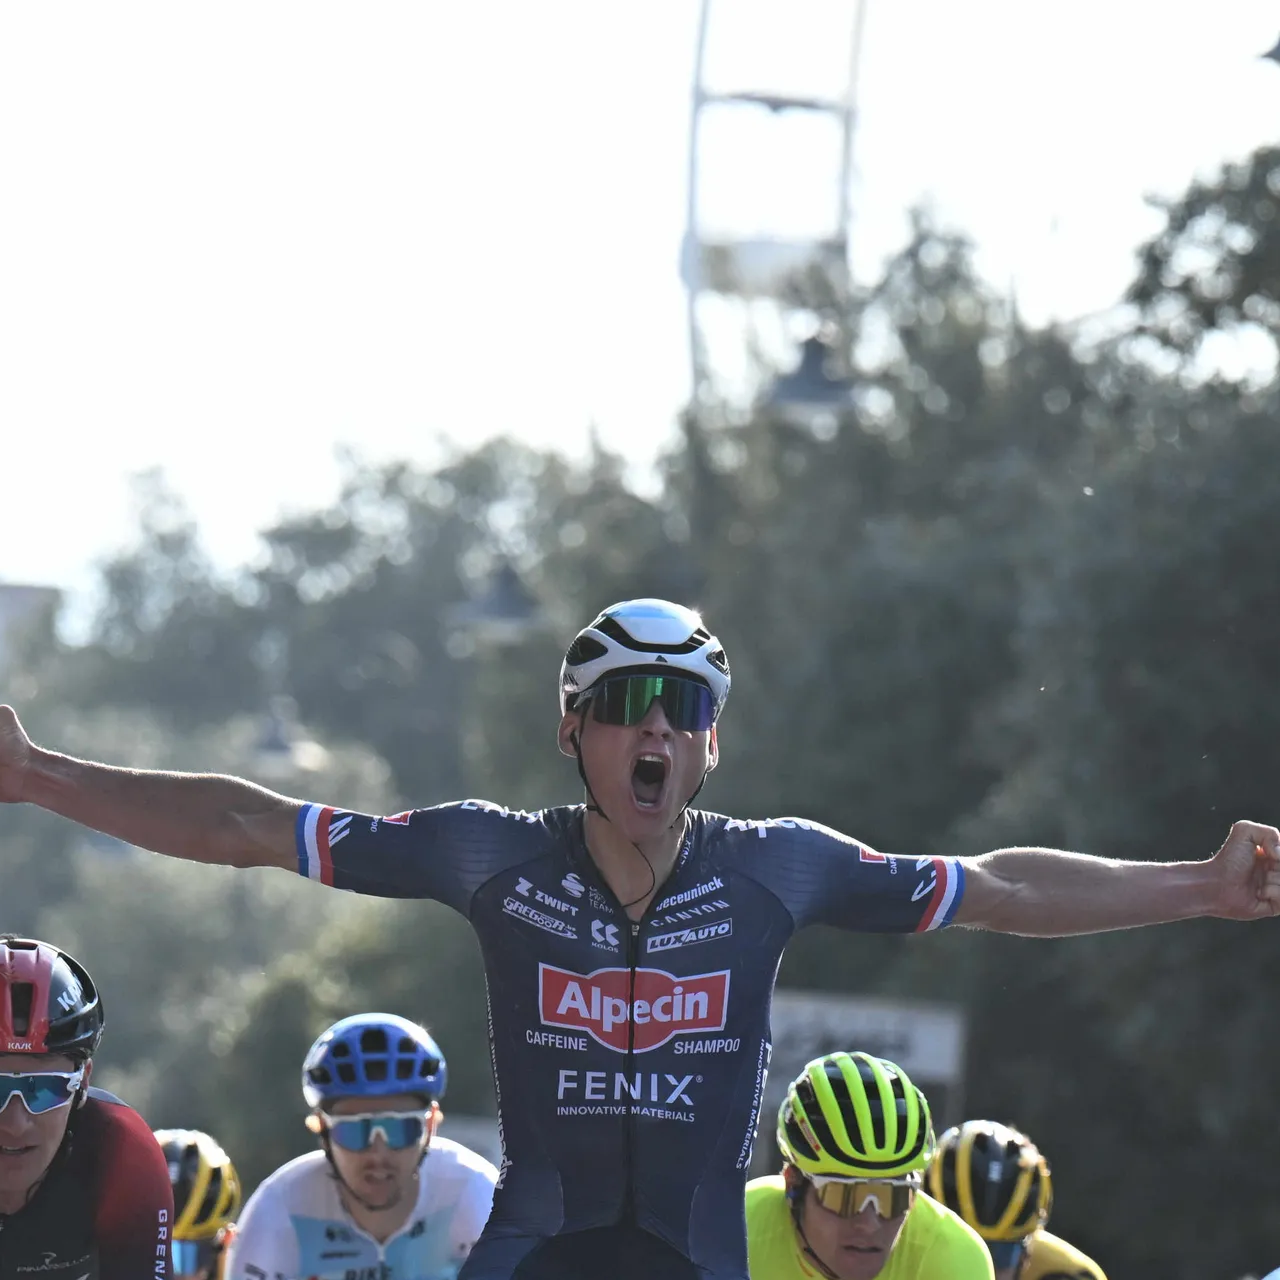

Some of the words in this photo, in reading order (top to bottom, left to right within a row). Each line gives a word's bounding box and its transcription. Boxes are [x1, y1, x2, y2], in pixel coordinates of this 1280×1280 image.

[535, 889, 579, 916] ZWIFT
[650, 899, 731, 927] CANYON
[591, 941, 619, 954] KOLOS
[556, 981, 709, 1032] Alpecin
[525, 1030, 588, 1051] CAFFEINE
[673, 1038, 741, 1054] SHAMPOO
[752, 1038, 765, 1106] INNOVATIVE
[557, 1106, 627, 1116] INNOVATIVE
[631, 1106, 695, 1122] MATERIALS
[736, 1109, 757, 1169] MATERIALS
